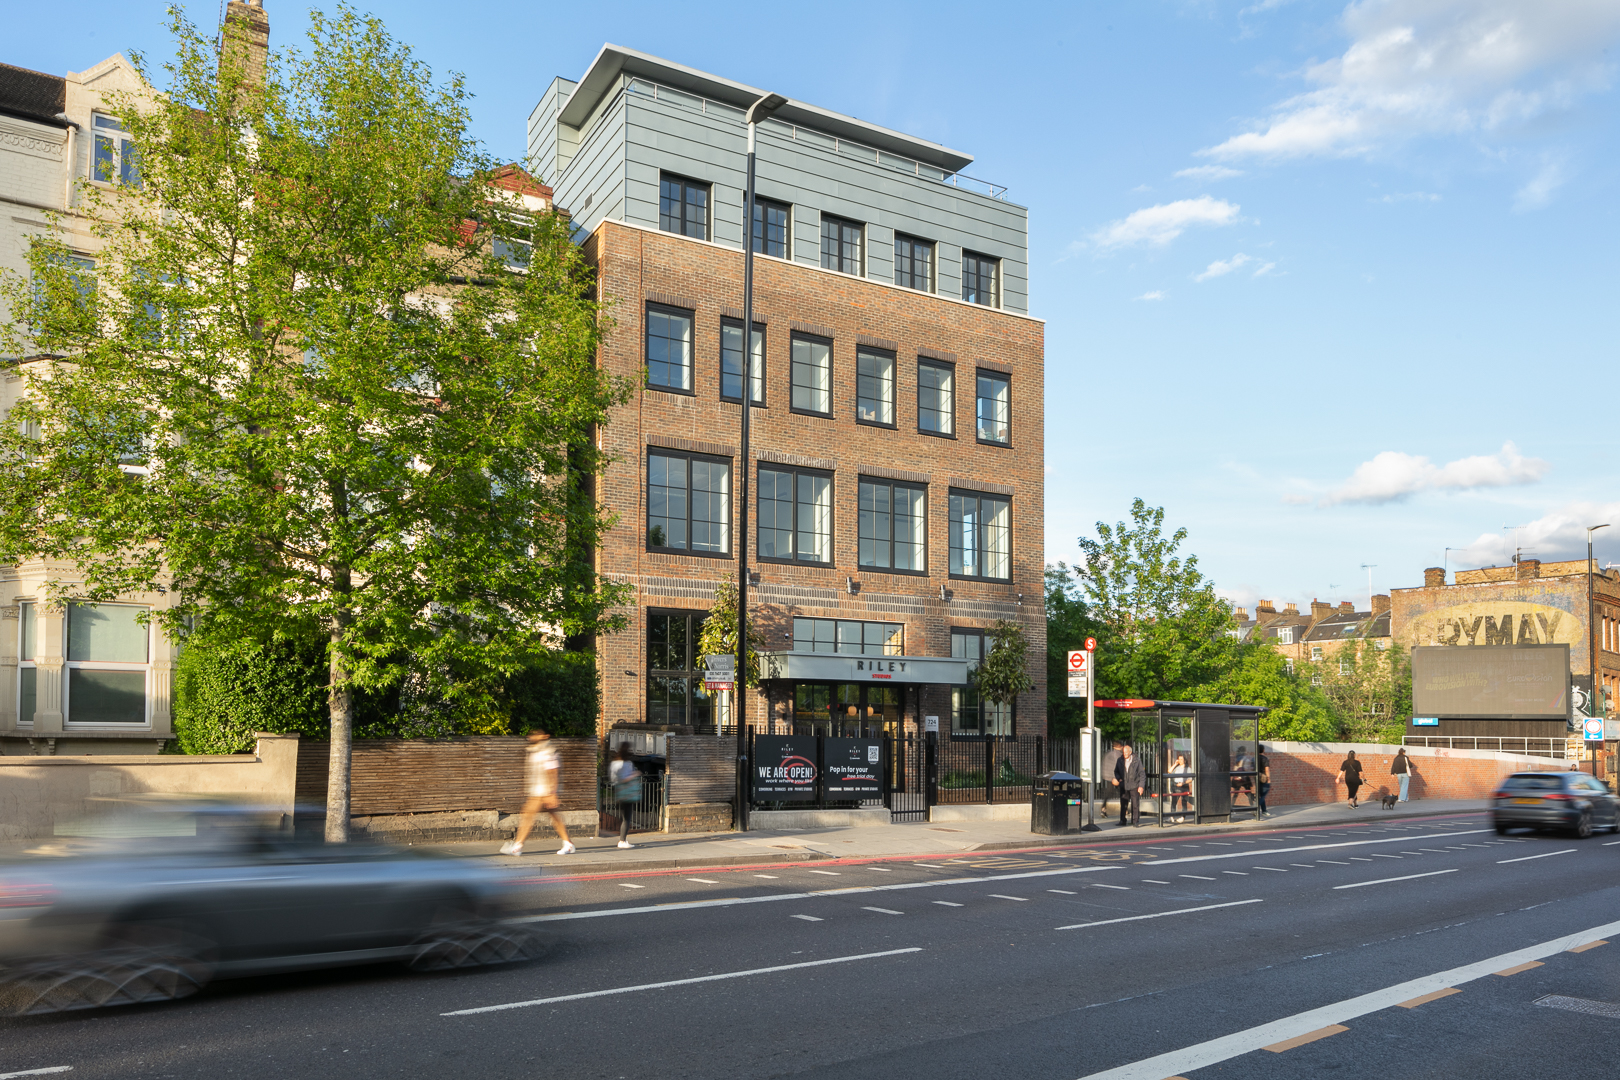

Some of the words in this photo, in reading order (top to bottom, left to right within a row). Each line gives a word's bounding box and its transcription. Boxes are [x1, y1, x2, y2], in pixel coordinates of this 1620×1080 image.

[1088, 640, 1093, 649] S
[857, 661, 906, 672] RILEY
[1466, 672, 1480, 680] YOU
[759, 767, 771, 778] WE
[774, 767, 788, 778] ARE
[791, 767, 812, 778] OPEN!
[830, 766, 840, 774] Pop
